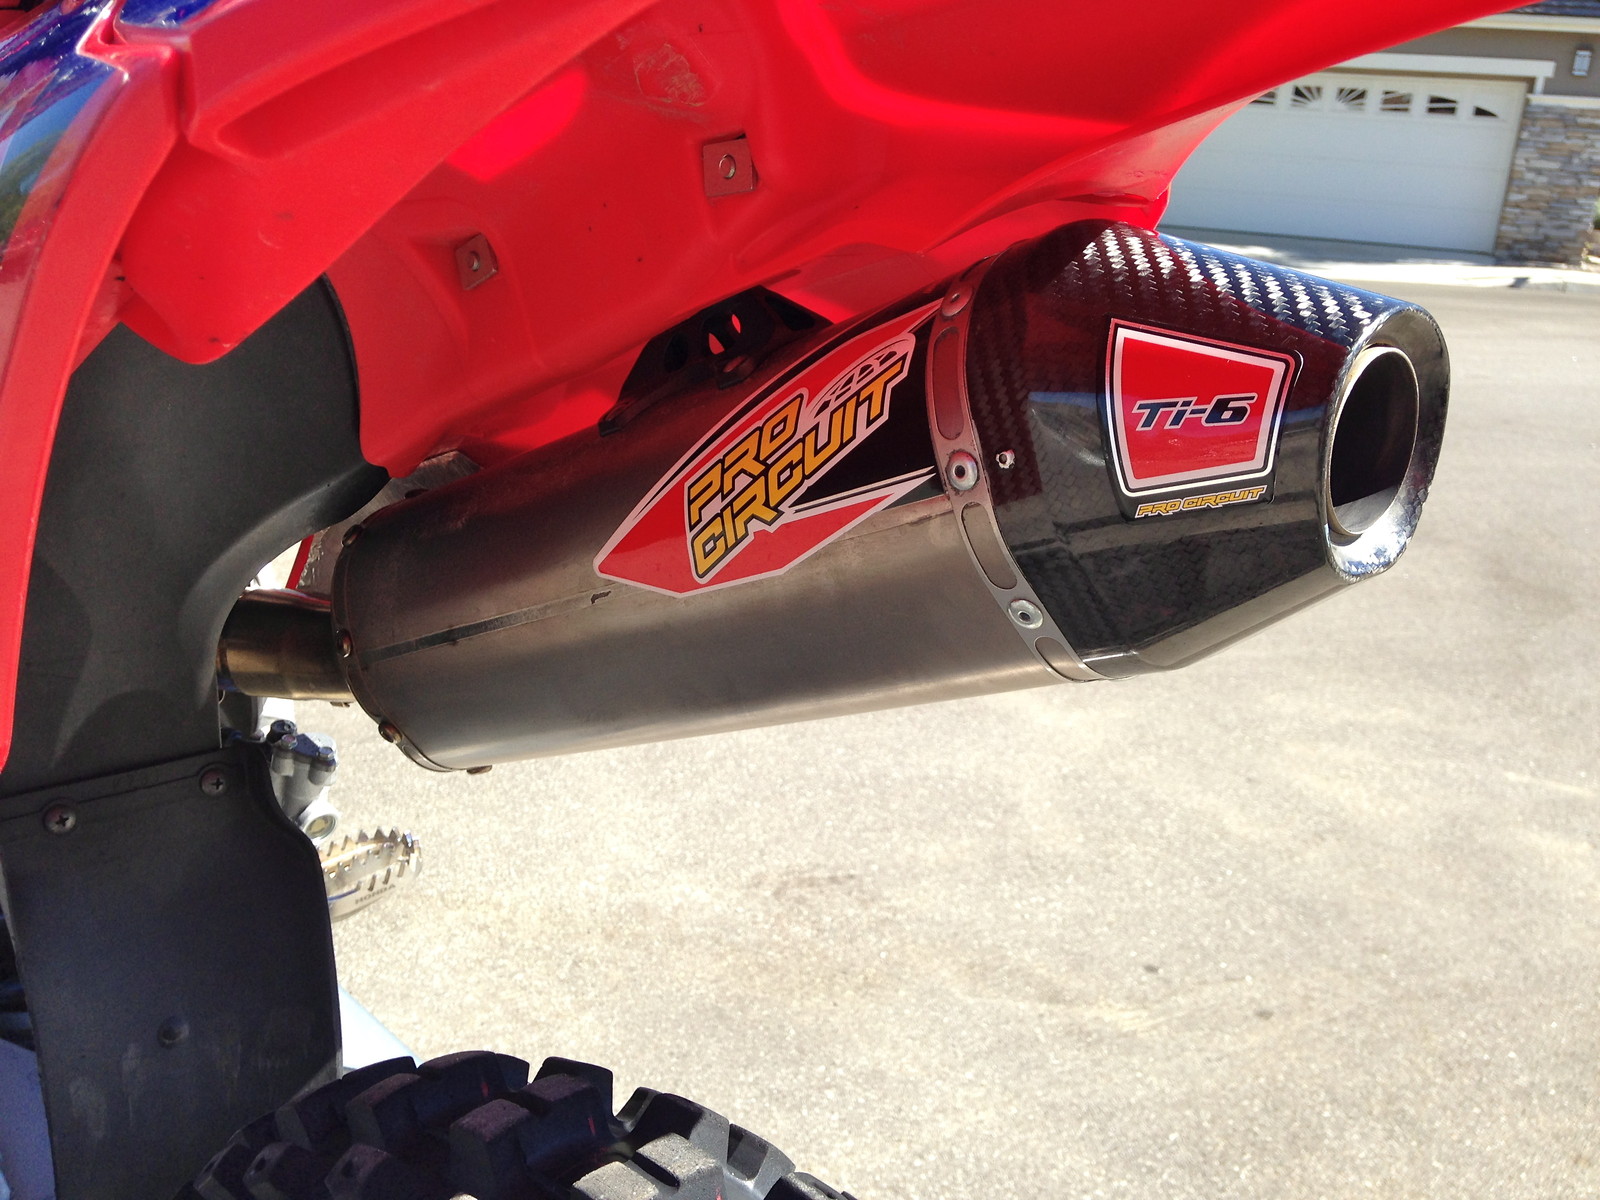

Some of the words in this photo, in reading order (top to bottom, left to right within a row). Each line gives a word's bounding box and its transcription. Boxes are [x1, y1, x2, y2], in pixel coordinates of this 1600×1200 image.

[1133, 393, 1258, 430] Ti-6
[689, 393, 804, 526] PRO
[691, 357, 906, 578] CIRCUIT
[1135, 499, 1181, 517] PRO
[1182, 486, 1266, 509] CIRCUIT
[355, 884, 396, 903] HONDA
